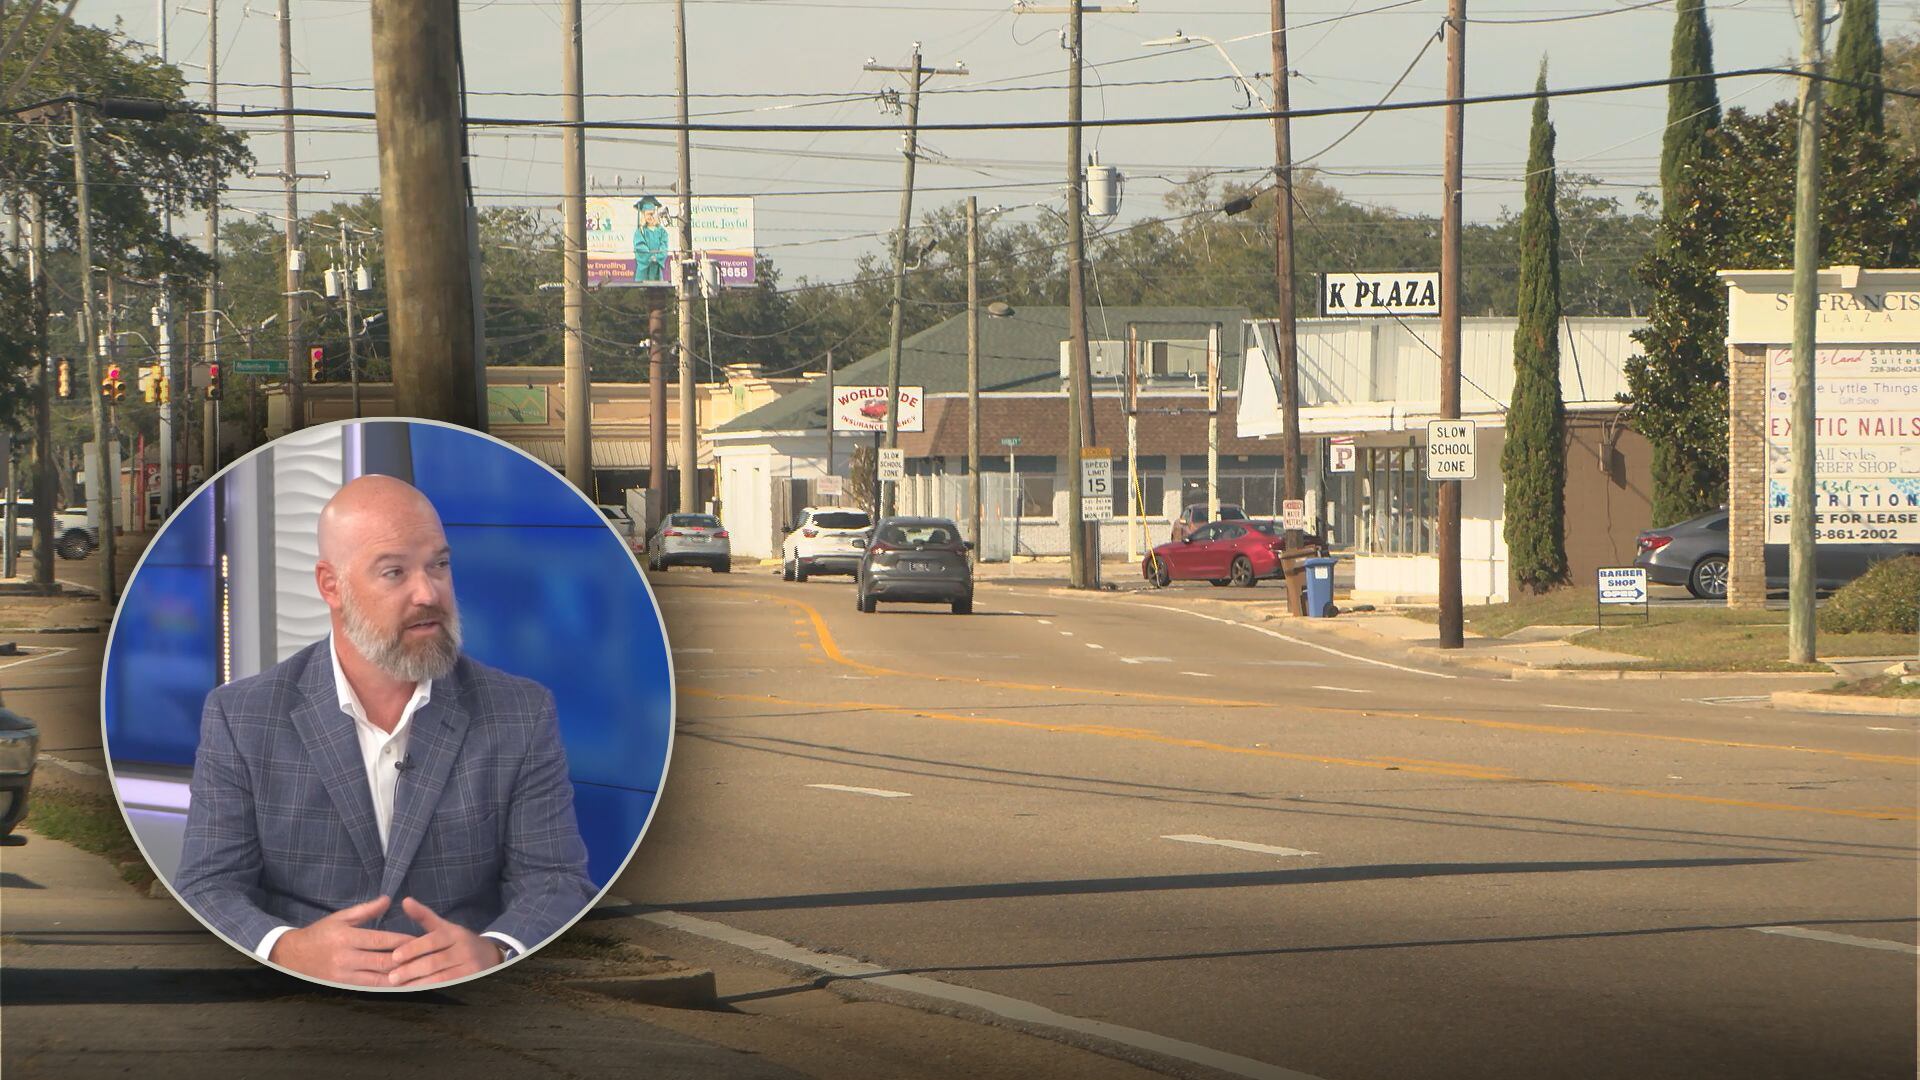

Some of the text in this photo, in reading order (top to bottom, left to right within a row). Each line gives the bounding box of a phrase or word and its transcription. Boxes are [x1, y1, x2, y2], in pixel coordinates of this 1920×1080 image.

[594, 262, 626, 271] Enrolling
[1329, 280, 1436, 308] K PLAZA
[1816, 292, 1920, 311] FRANCIS
[1823, 314, 1893, 323] LAZA
[1831, 348, 1864, 366] Land
[1872, 356, 1920, 364] Suites
[1830, 383, 1868, 396] Lyttle
[1873, 382, 1918, 396] Things
[838, 388, 918, 408] WORLDDE
[1857, 398, 1880, 406] Shop
[841, 415, 884, 430] INSURANCE
[1771, 418, 1920, 436] EXTIC NAILS
[1437, 426, 1466, 438] SLOW
[1431, 444, 1472, 455] SCHOOL
[1816, 448, 1876, 460] All Styles
[1336, 448, 1352, 470] P
[1437, 460, 1466, 472] ZONE
[1816, 462, 1897, 473] RBER SHOP
[1088, 478, 1106, 492] 15
[1776, 494, 1918, 507] NTRITION
[1774, 514, 1918, 524] SPE FOR LEASE
[1814, 529, 1898, 539] 8-861-2002
